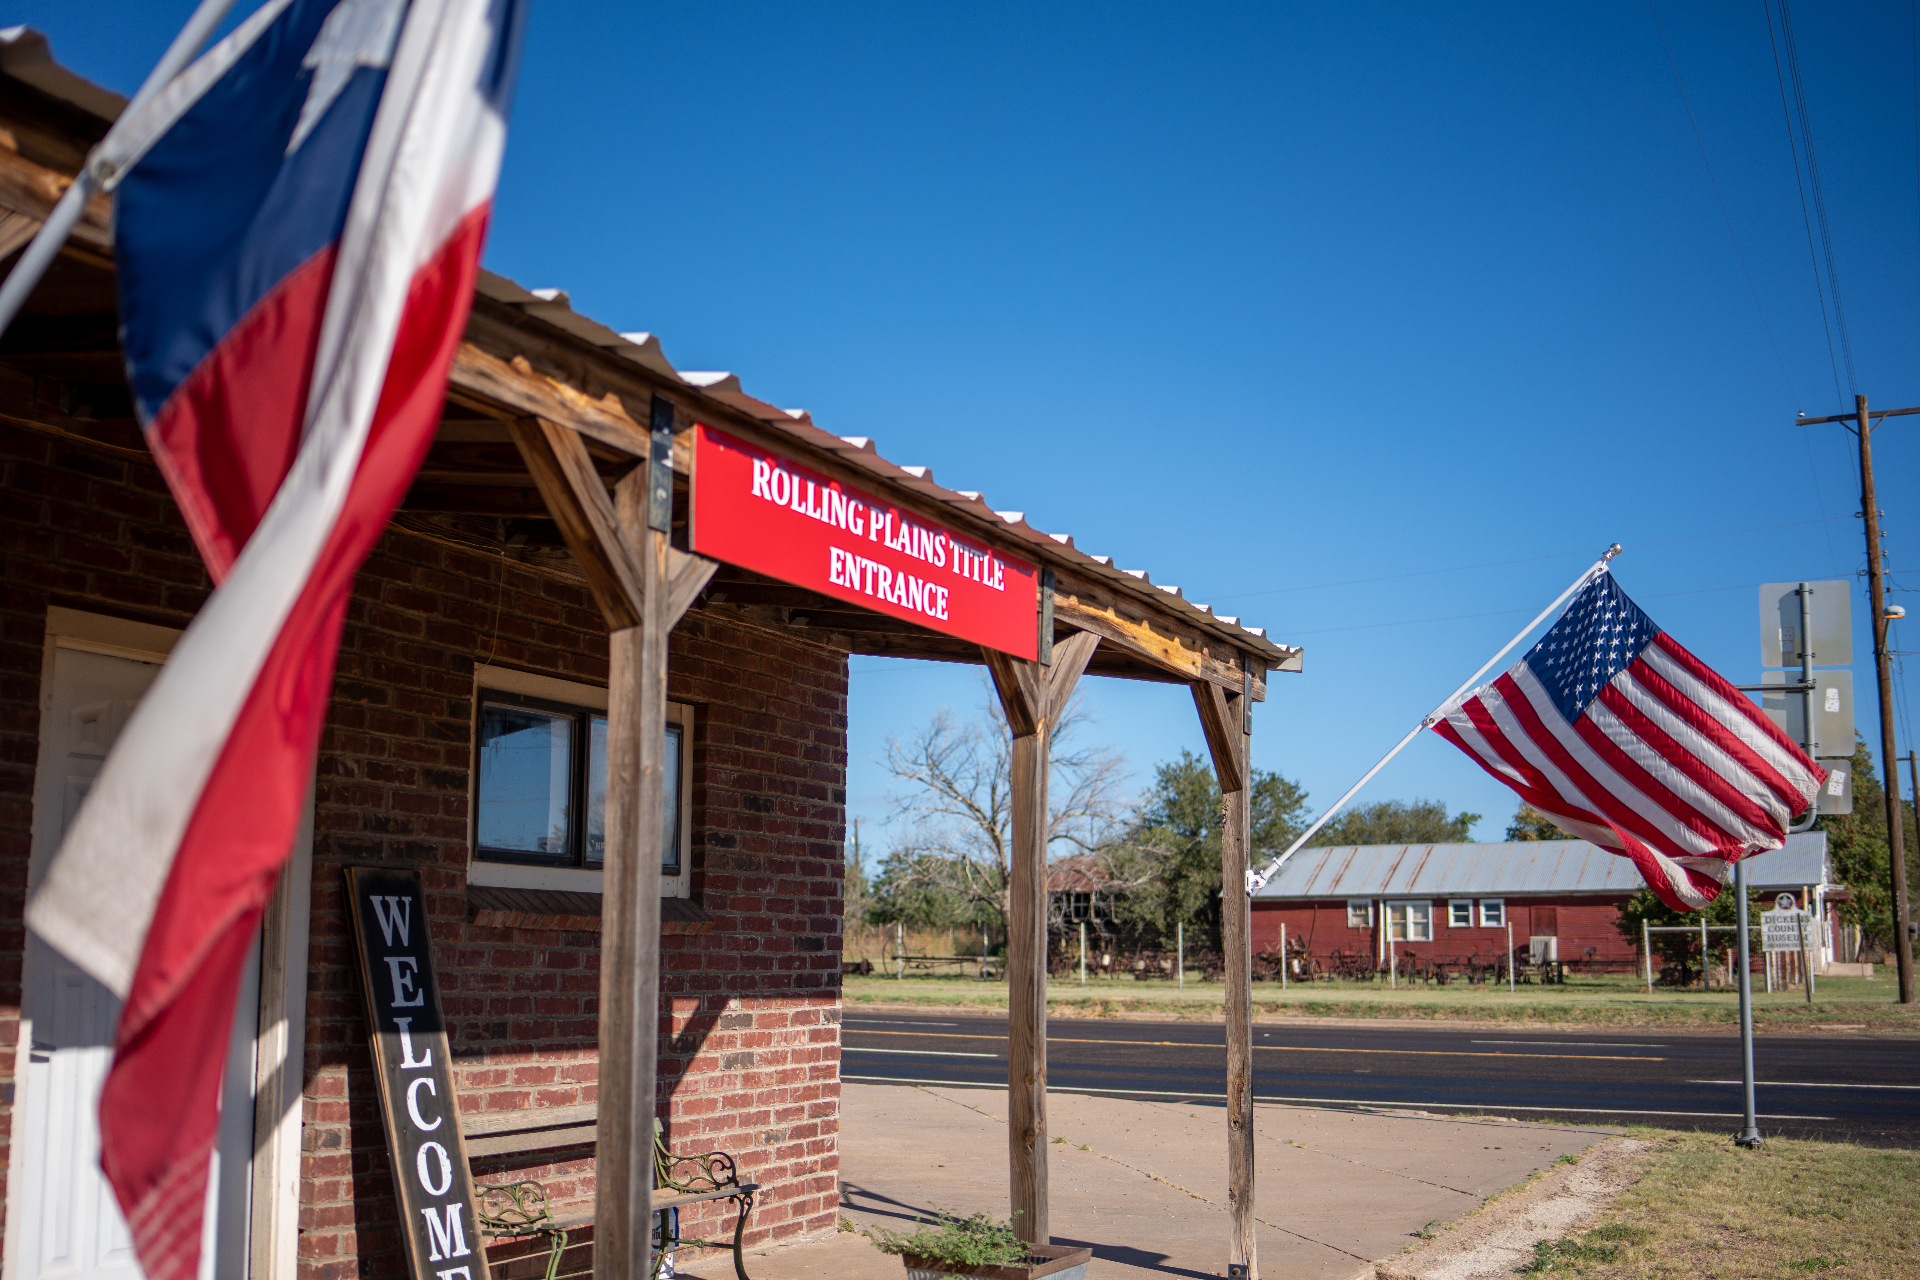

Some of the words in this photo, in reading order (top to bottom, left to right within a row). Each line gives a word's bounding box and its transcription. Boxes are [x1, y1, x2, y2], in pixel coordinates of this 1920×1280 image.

[752, 457, 864, 537] ROLLING
[869, 504, 947, 569] PLAINS
[949, 541, 1006, 593] TITLE
[828, 545, 949, 621] ENTRANCE
[369, 895, 471, 1280] WELCOM
